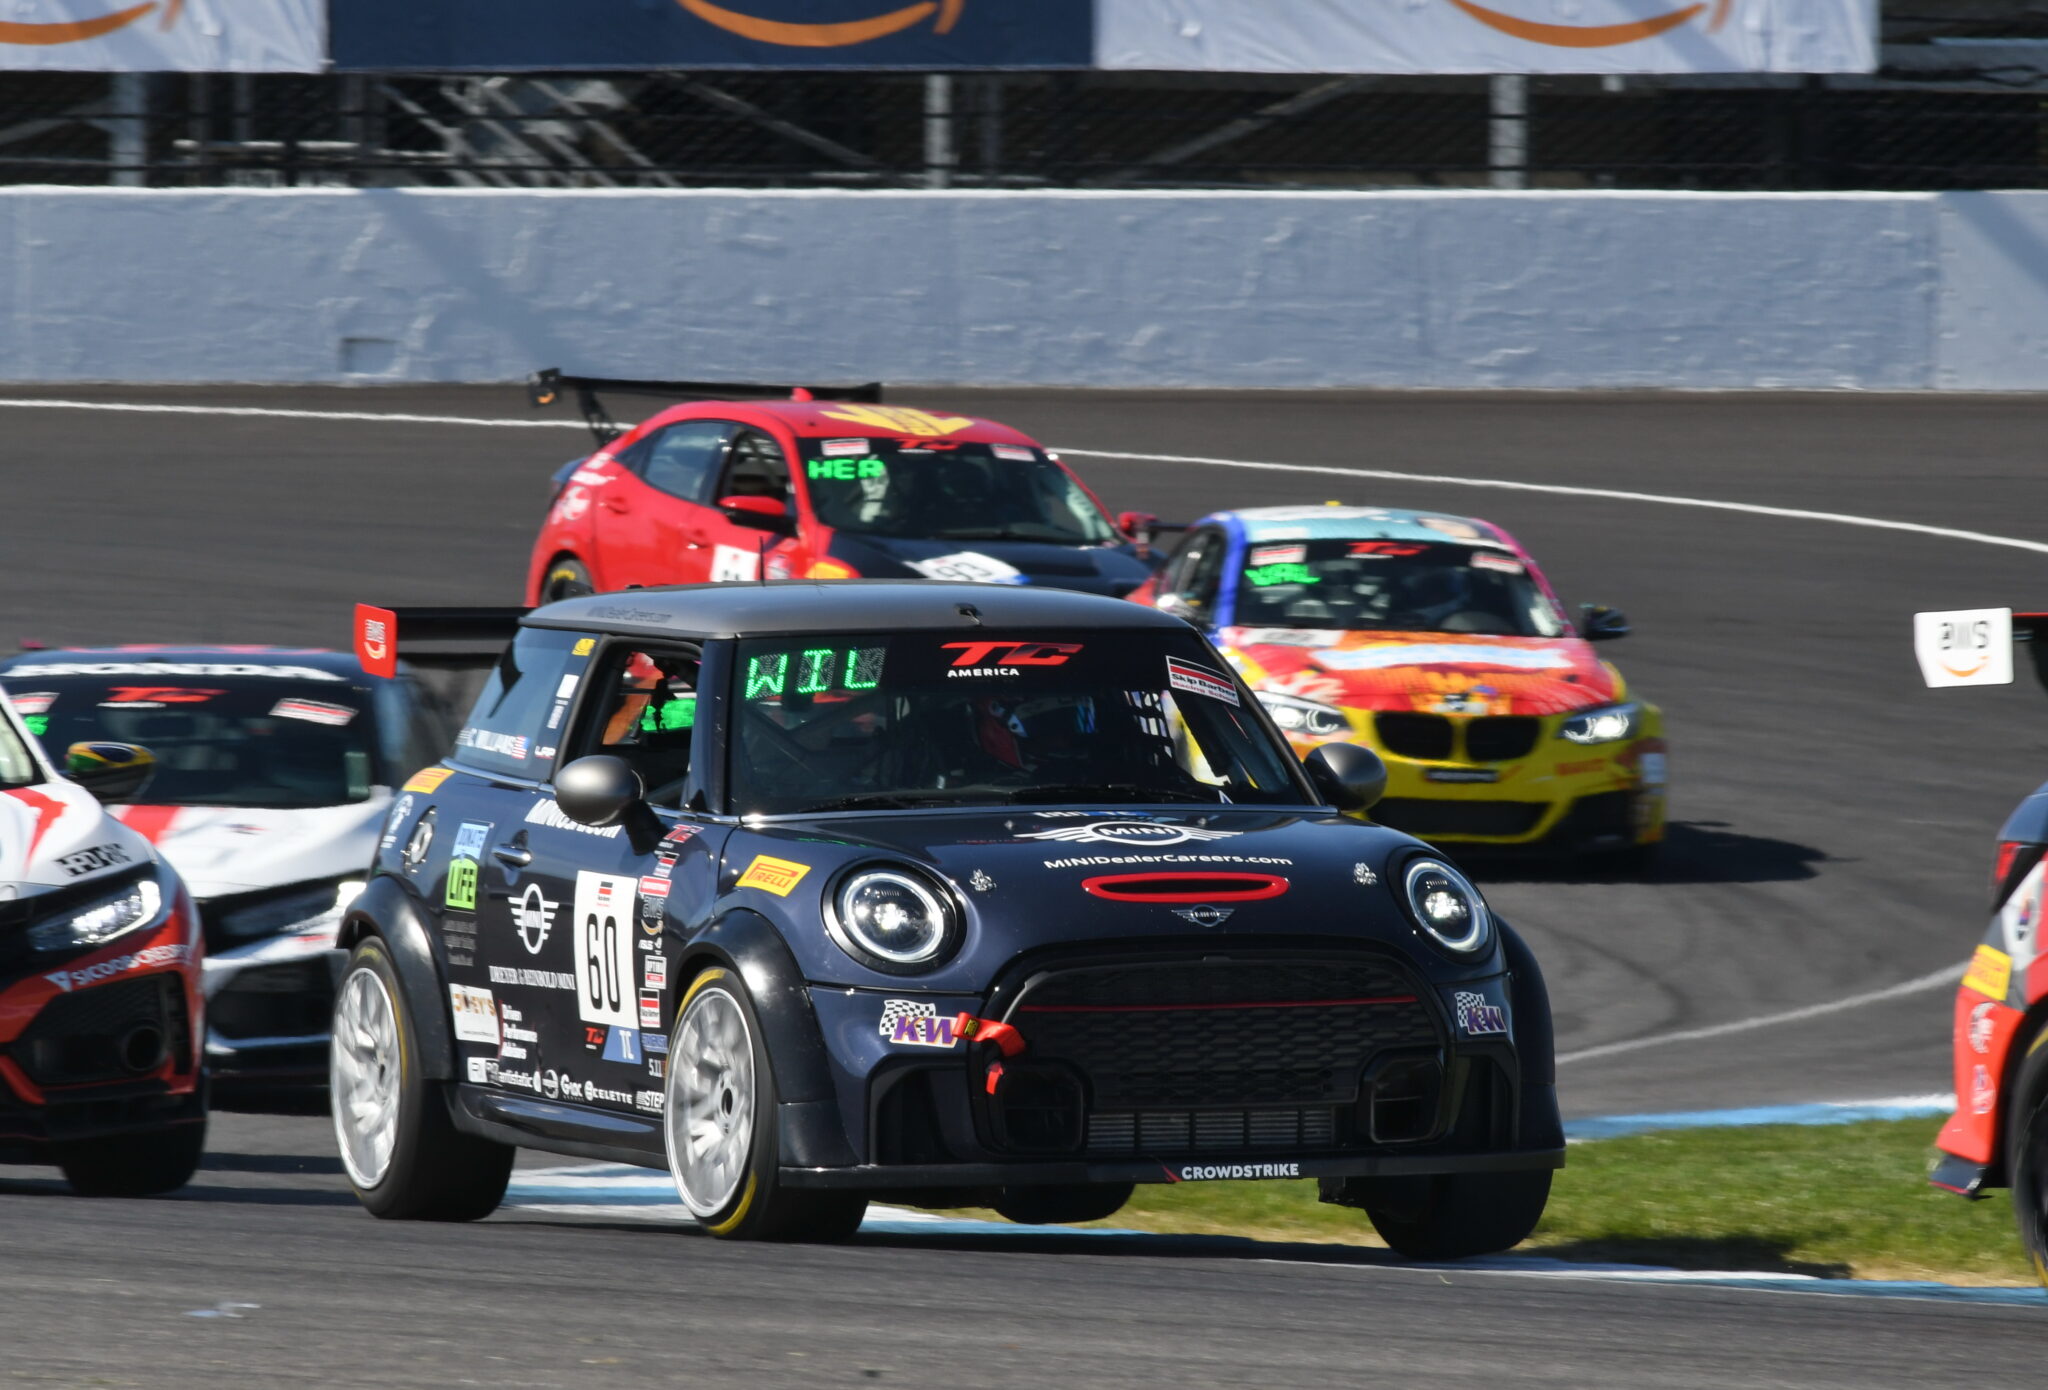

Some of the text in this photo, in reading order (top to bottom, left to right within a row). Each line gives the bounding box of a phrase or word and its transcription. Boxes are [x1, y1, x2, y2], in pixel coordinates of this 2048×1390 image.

[808, 458, 885, 480] HER
[941, 641, 1084, 666] TC
[744, 648, 878, 699] WIL
[947, 668, 1020, 678] AMERICA
[1099, 826, 1176, 836] MINI
[1043, 853, 1293, 869] MINIDealerCareers.com
[746, 862, 799, 888] PIRELLI
[586, 913, 620, 1012] 60
[893, 1015, 959, 1045] KW
[1466, 1007, 1505, 1032] KW
[593, 1088, 633, 1105] CELETTE
[1181, 1163, 1299, 1179] CROWDSTRIKE
